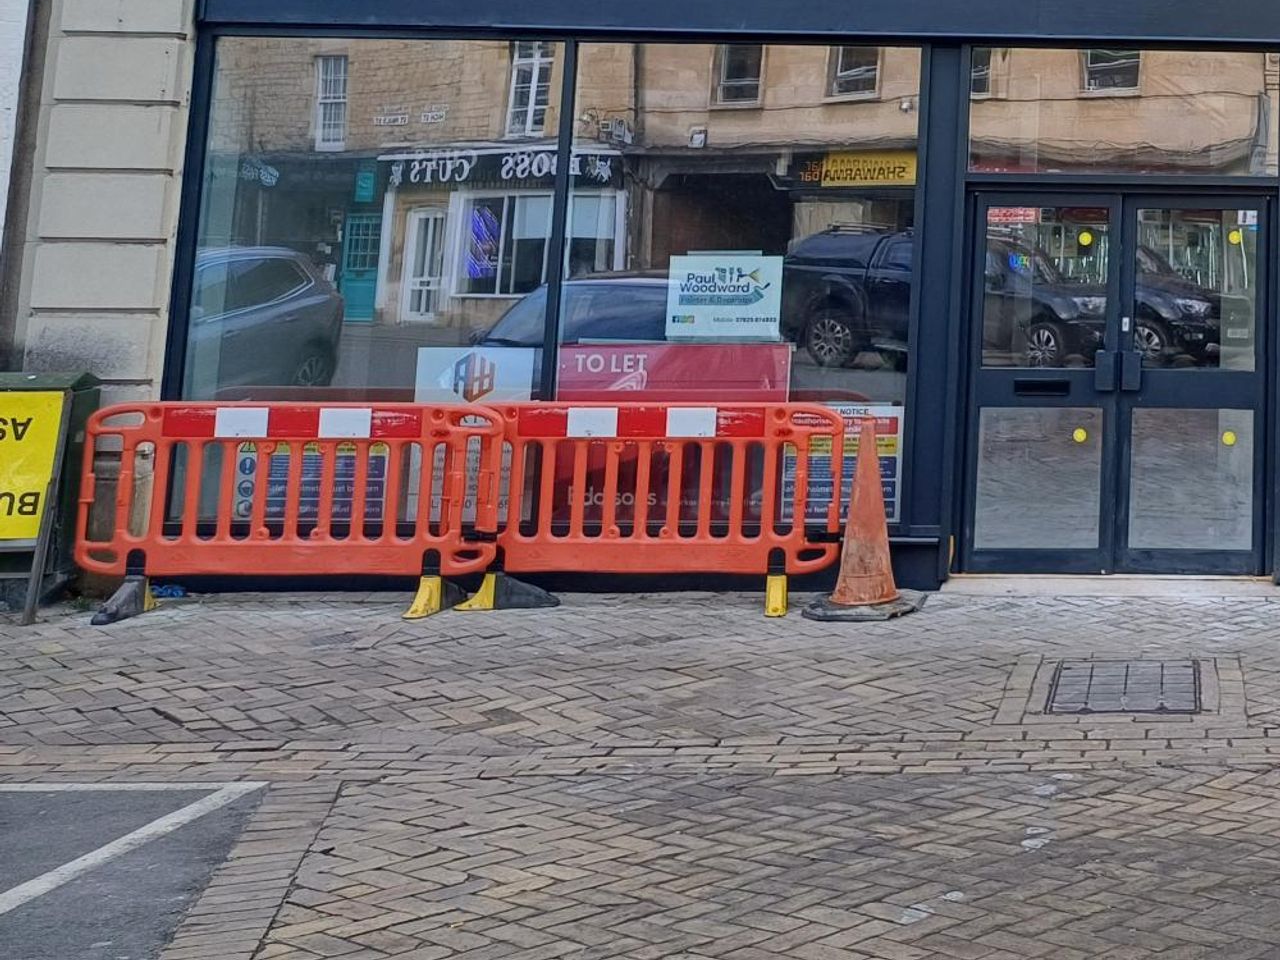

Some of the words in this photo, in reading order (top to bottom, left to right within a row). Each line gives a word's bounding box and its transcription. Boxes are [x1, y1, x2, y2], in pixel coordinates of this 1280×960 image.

[687, 272, 716, 284] Paul
[679, 282, 751, 293] Woodward
[575, 354, 605, 373] TO
[611, 354, 648, 373] LET
[840, 408, 870, 416] NOTICE
